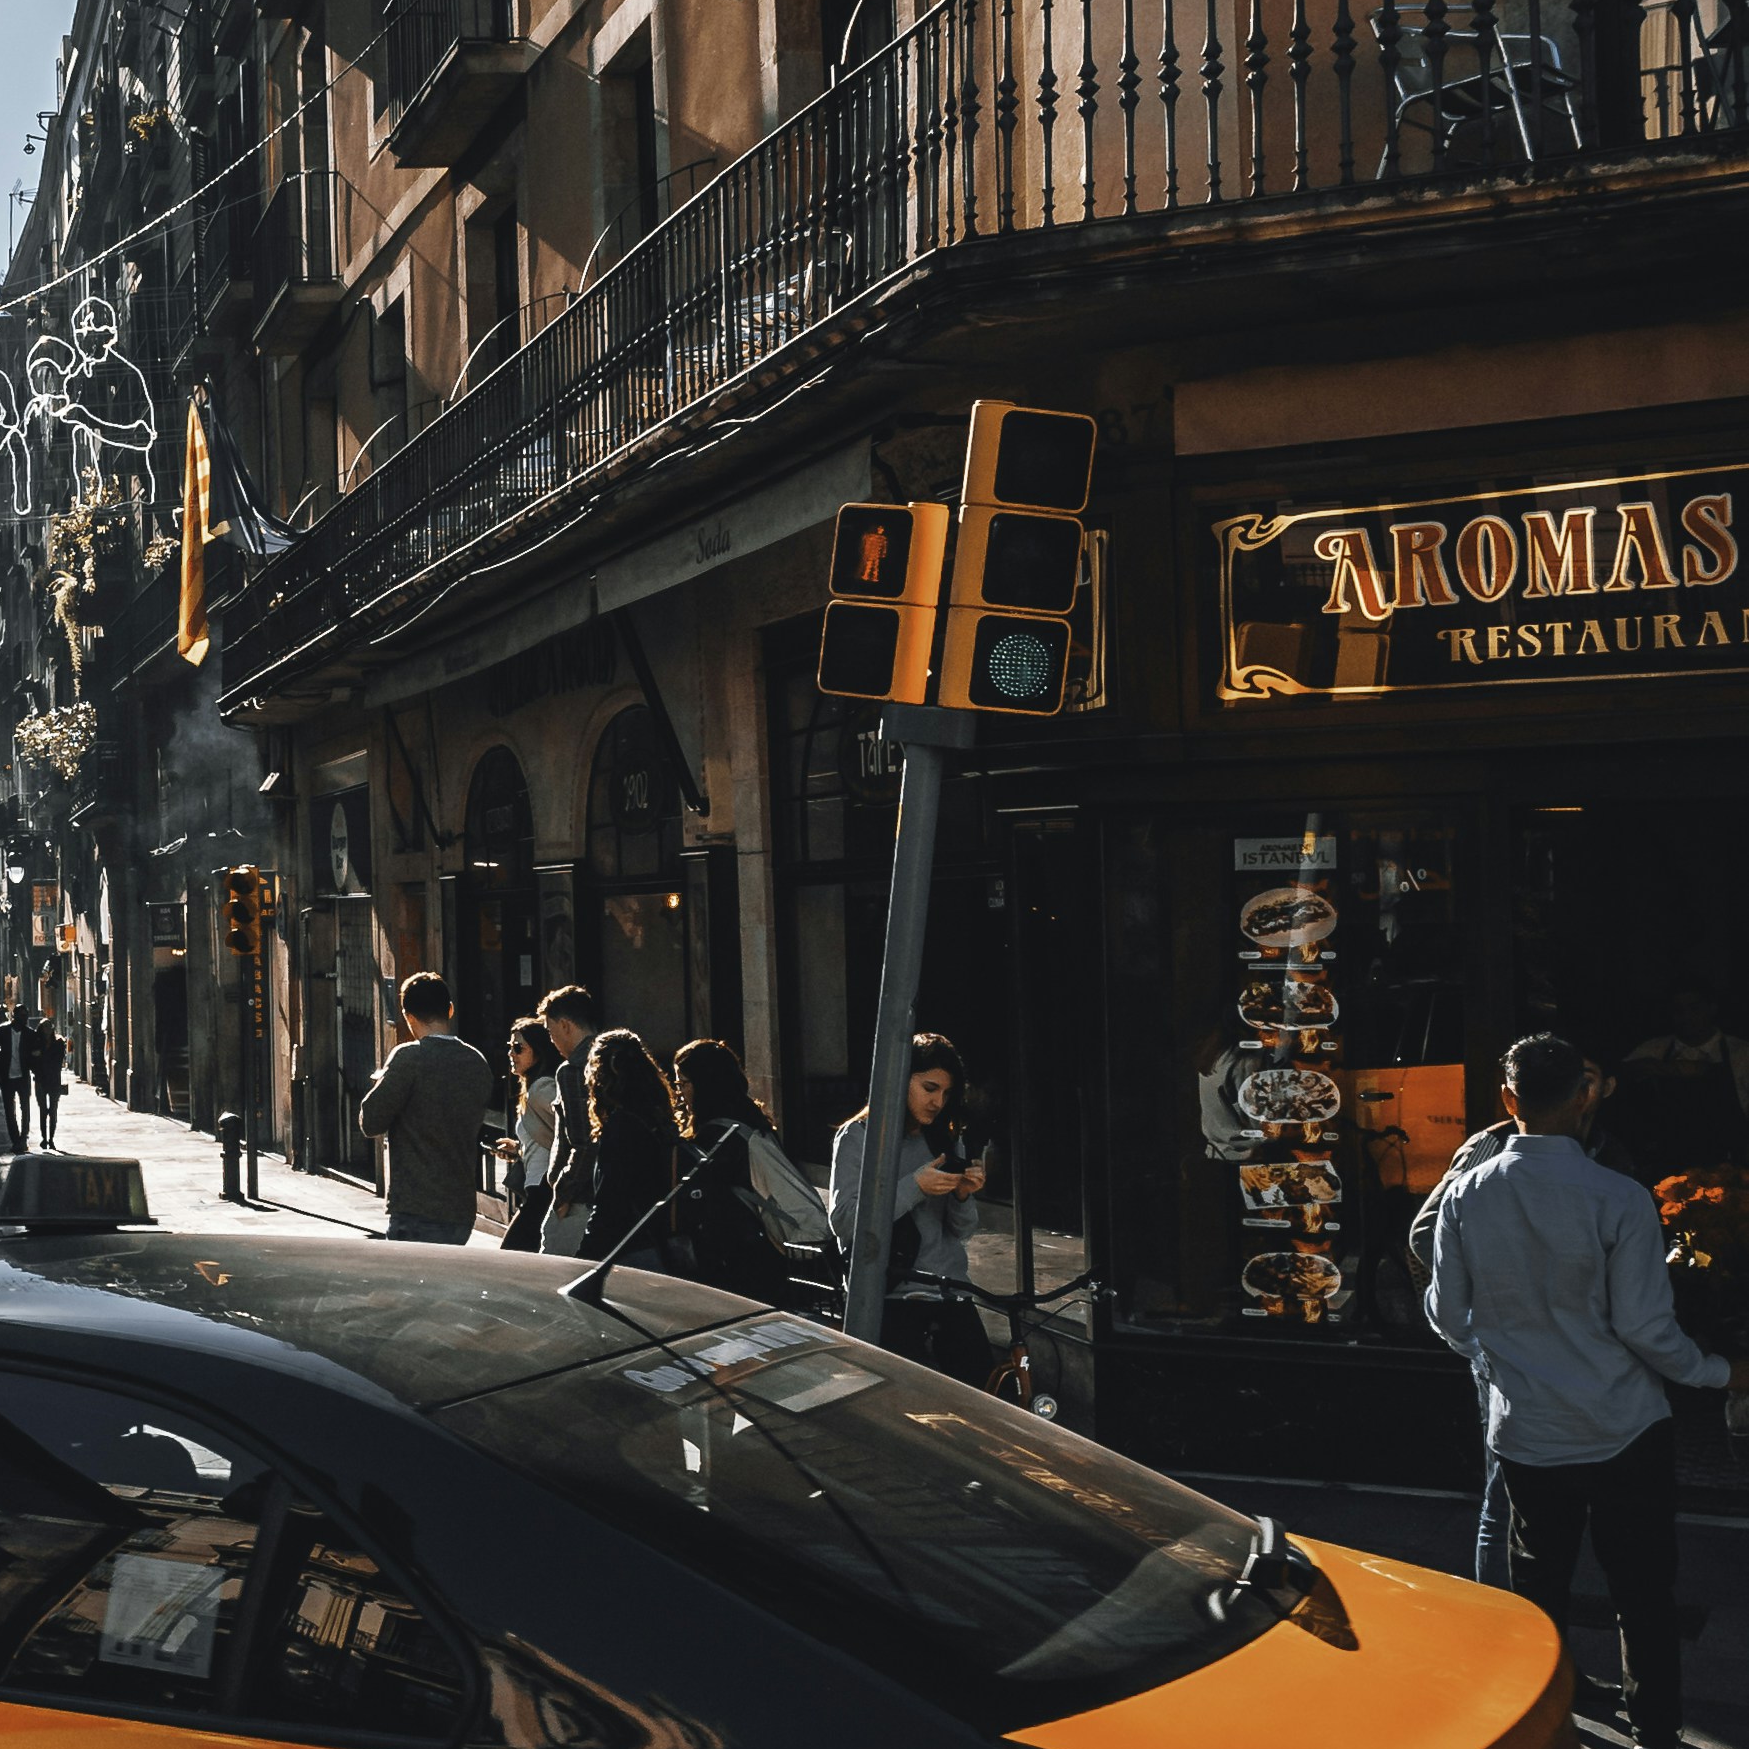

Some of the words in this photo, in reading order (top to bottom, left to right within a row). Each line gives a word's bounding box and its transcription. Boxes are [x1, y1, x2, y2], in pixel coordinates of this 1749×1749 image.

[1314, 493, 1738, 621] AROMAS
[1436, 608, 1749, 665] RESTAURA
[1243, 852, 1330, 865] ISTANBUL
